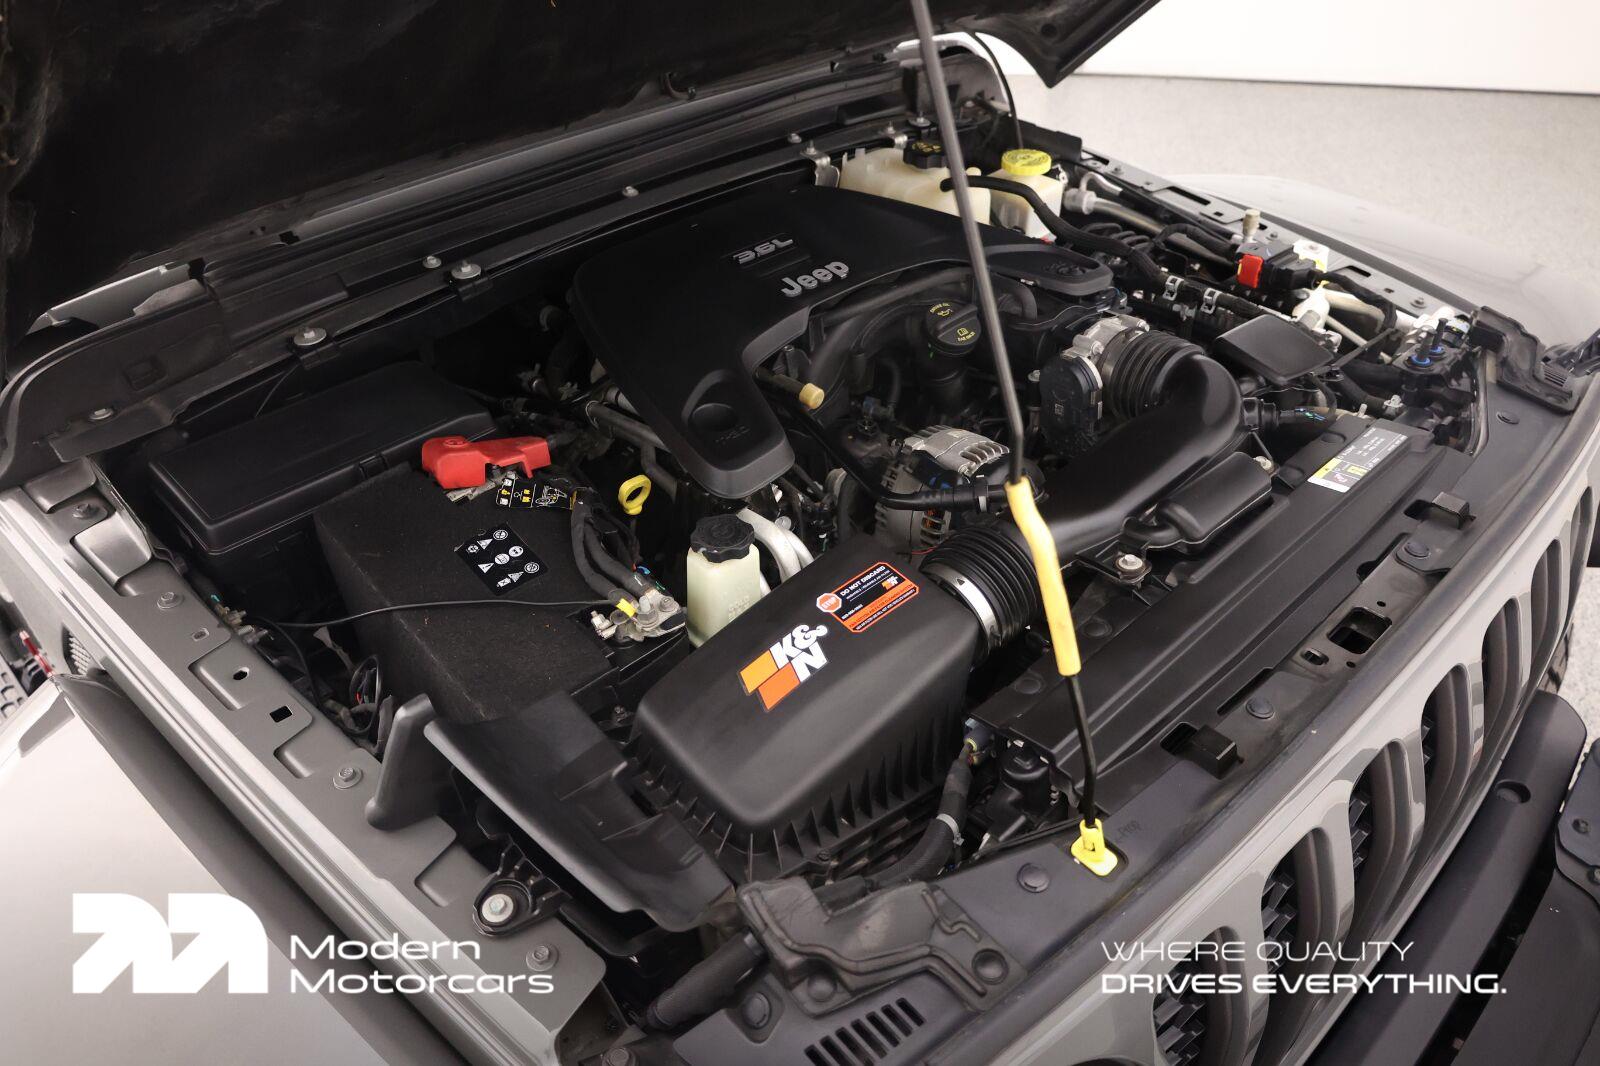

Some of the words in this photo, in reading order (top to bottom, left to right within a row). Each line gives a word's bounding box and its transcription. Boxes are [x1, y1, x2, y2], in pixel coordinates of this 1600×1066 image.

[781, 261, 849, 297] Jeep
[849, 580, 862, 591] NOT
[769, 624, 828, 682] K&N
